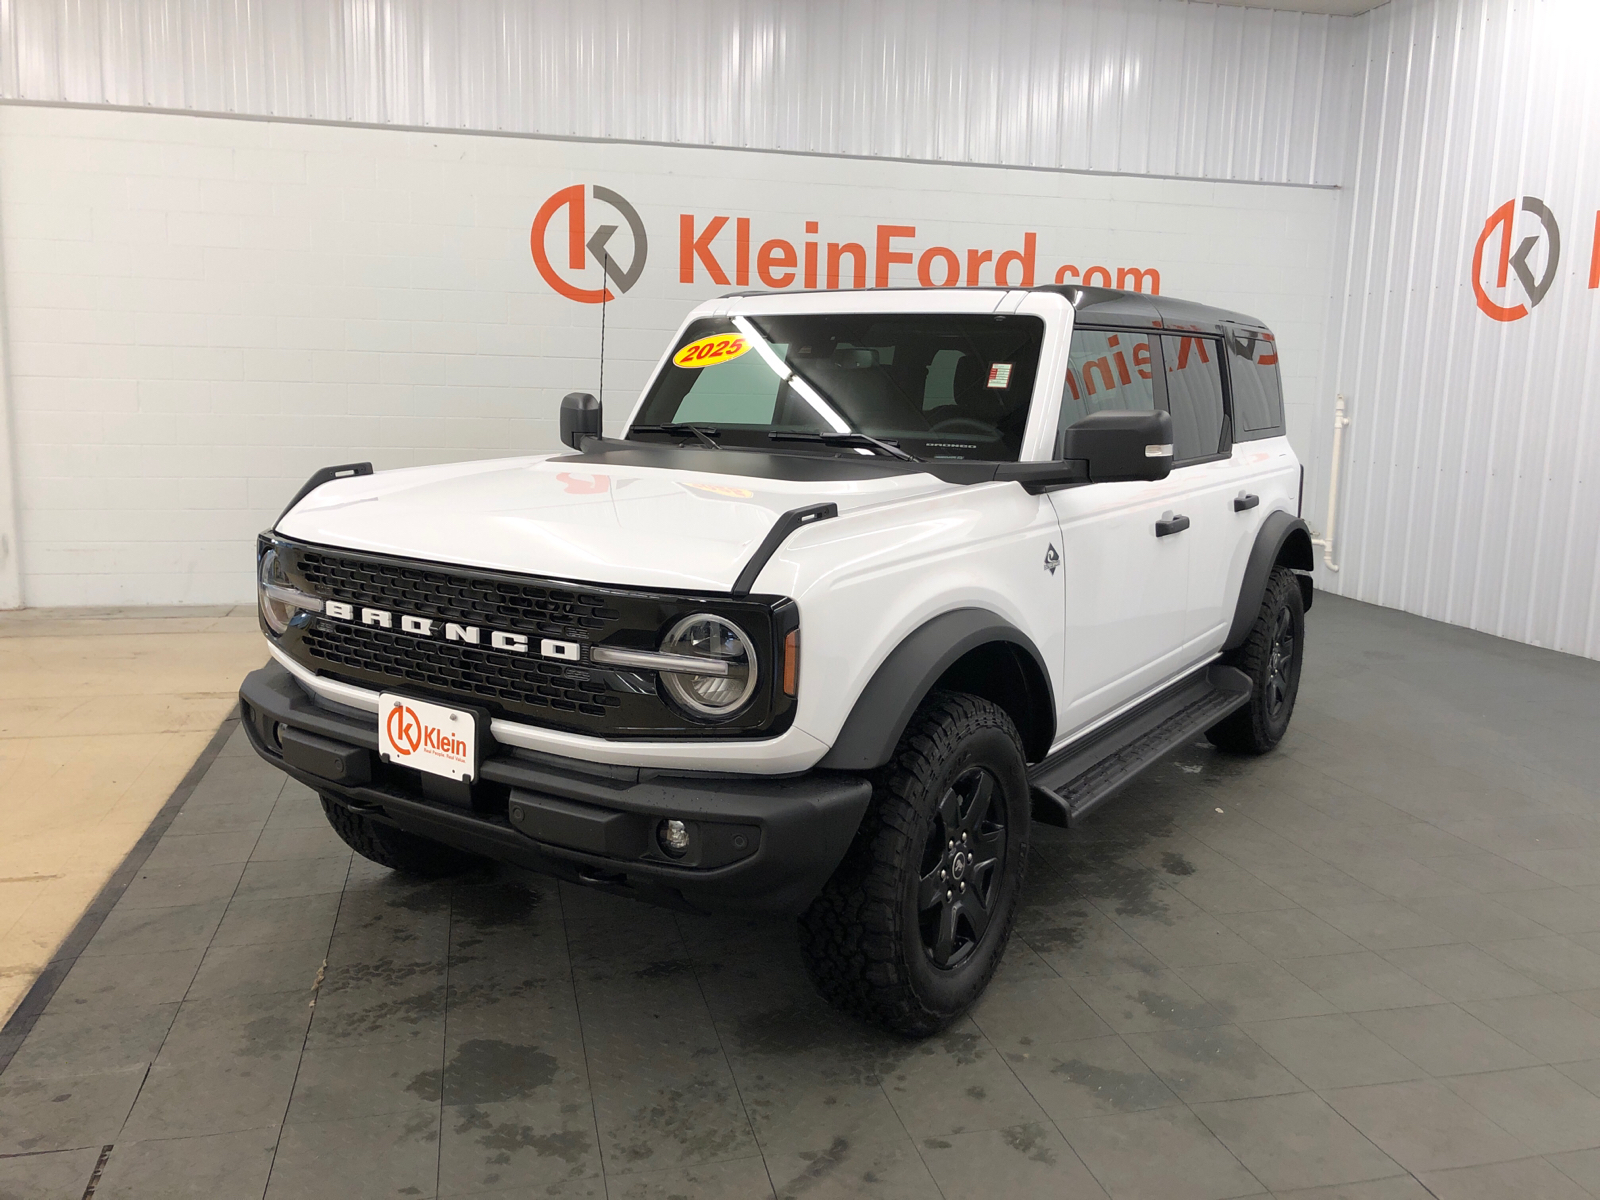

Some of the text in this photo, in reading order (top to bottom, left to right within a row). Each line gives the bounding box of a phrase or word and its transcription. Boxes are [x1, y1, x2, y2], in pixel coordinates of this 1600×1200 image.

[679, 213, 1161, 296] KleinFordcom
[679, 338, 746, 364] 2025
[325, 600, 581, 661] BRONCO
[424, 725, 466, 757] Klein
